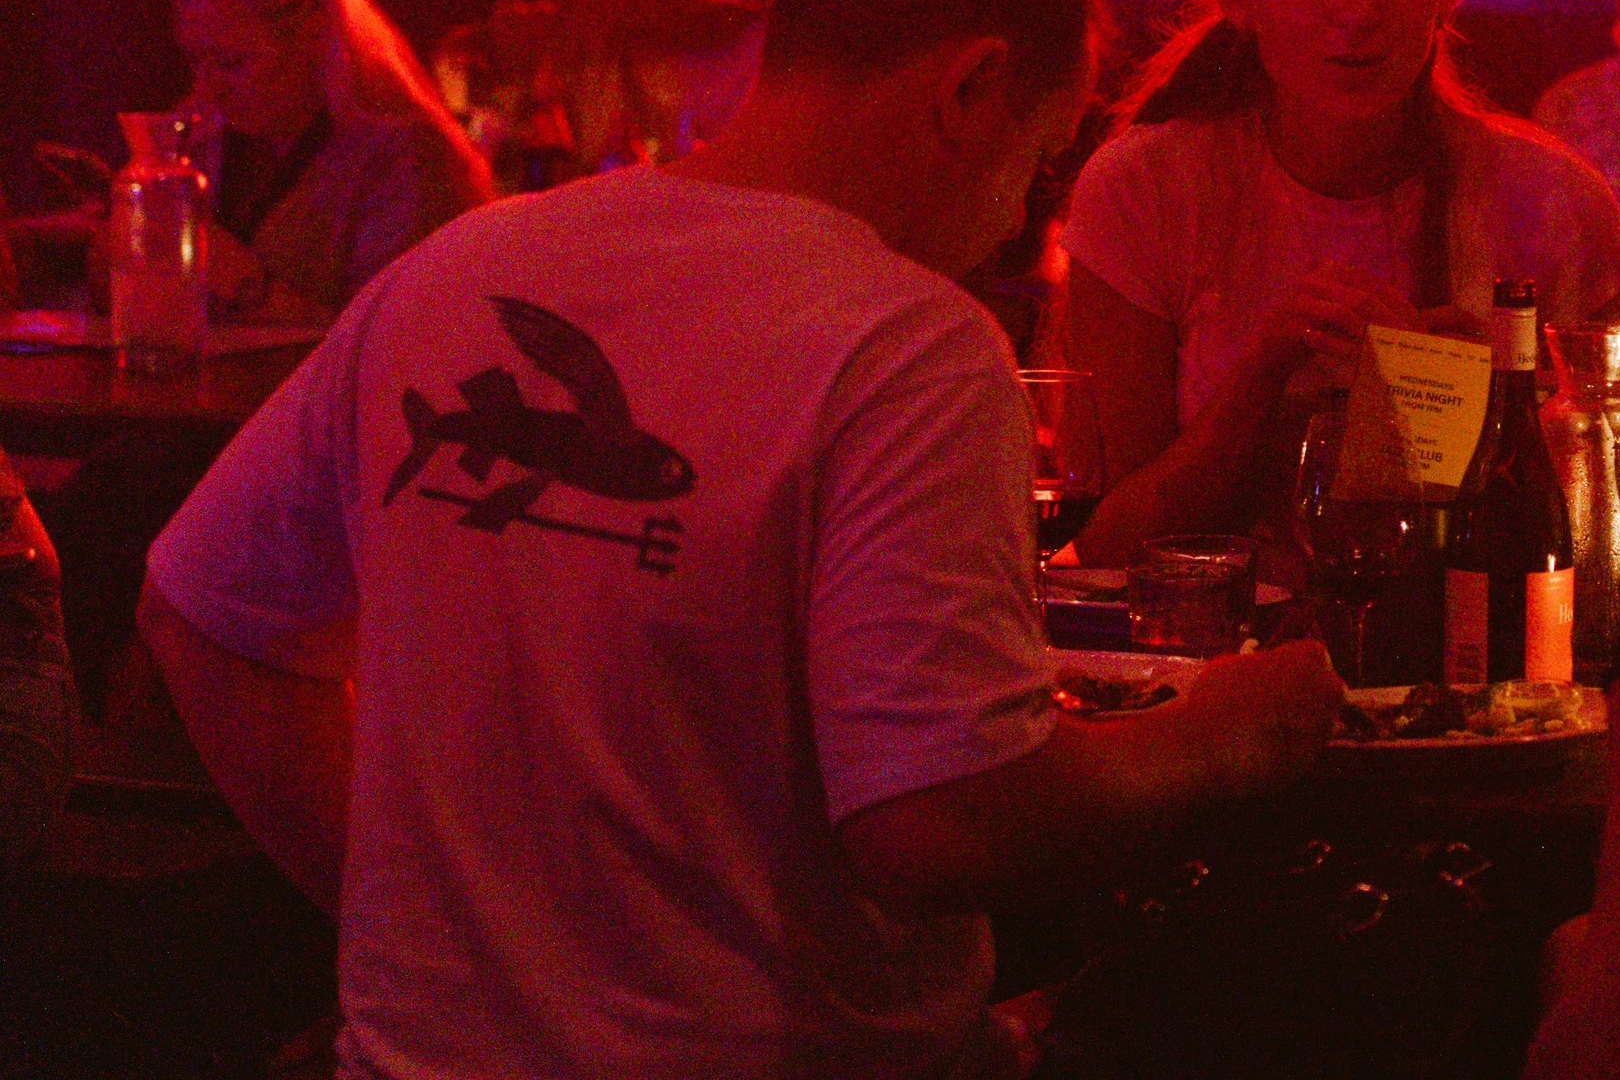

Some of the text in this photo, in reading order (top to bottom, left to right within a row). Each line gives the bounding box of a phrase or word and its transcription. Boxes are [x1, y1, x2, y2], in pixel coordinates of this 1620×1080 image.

[1399, 375, 1455, 391] WEDNESDAYS
[1386, 384, 1464, 407] TRIVIA NIGHT
[1401, 399, 1425, 410] FROM
